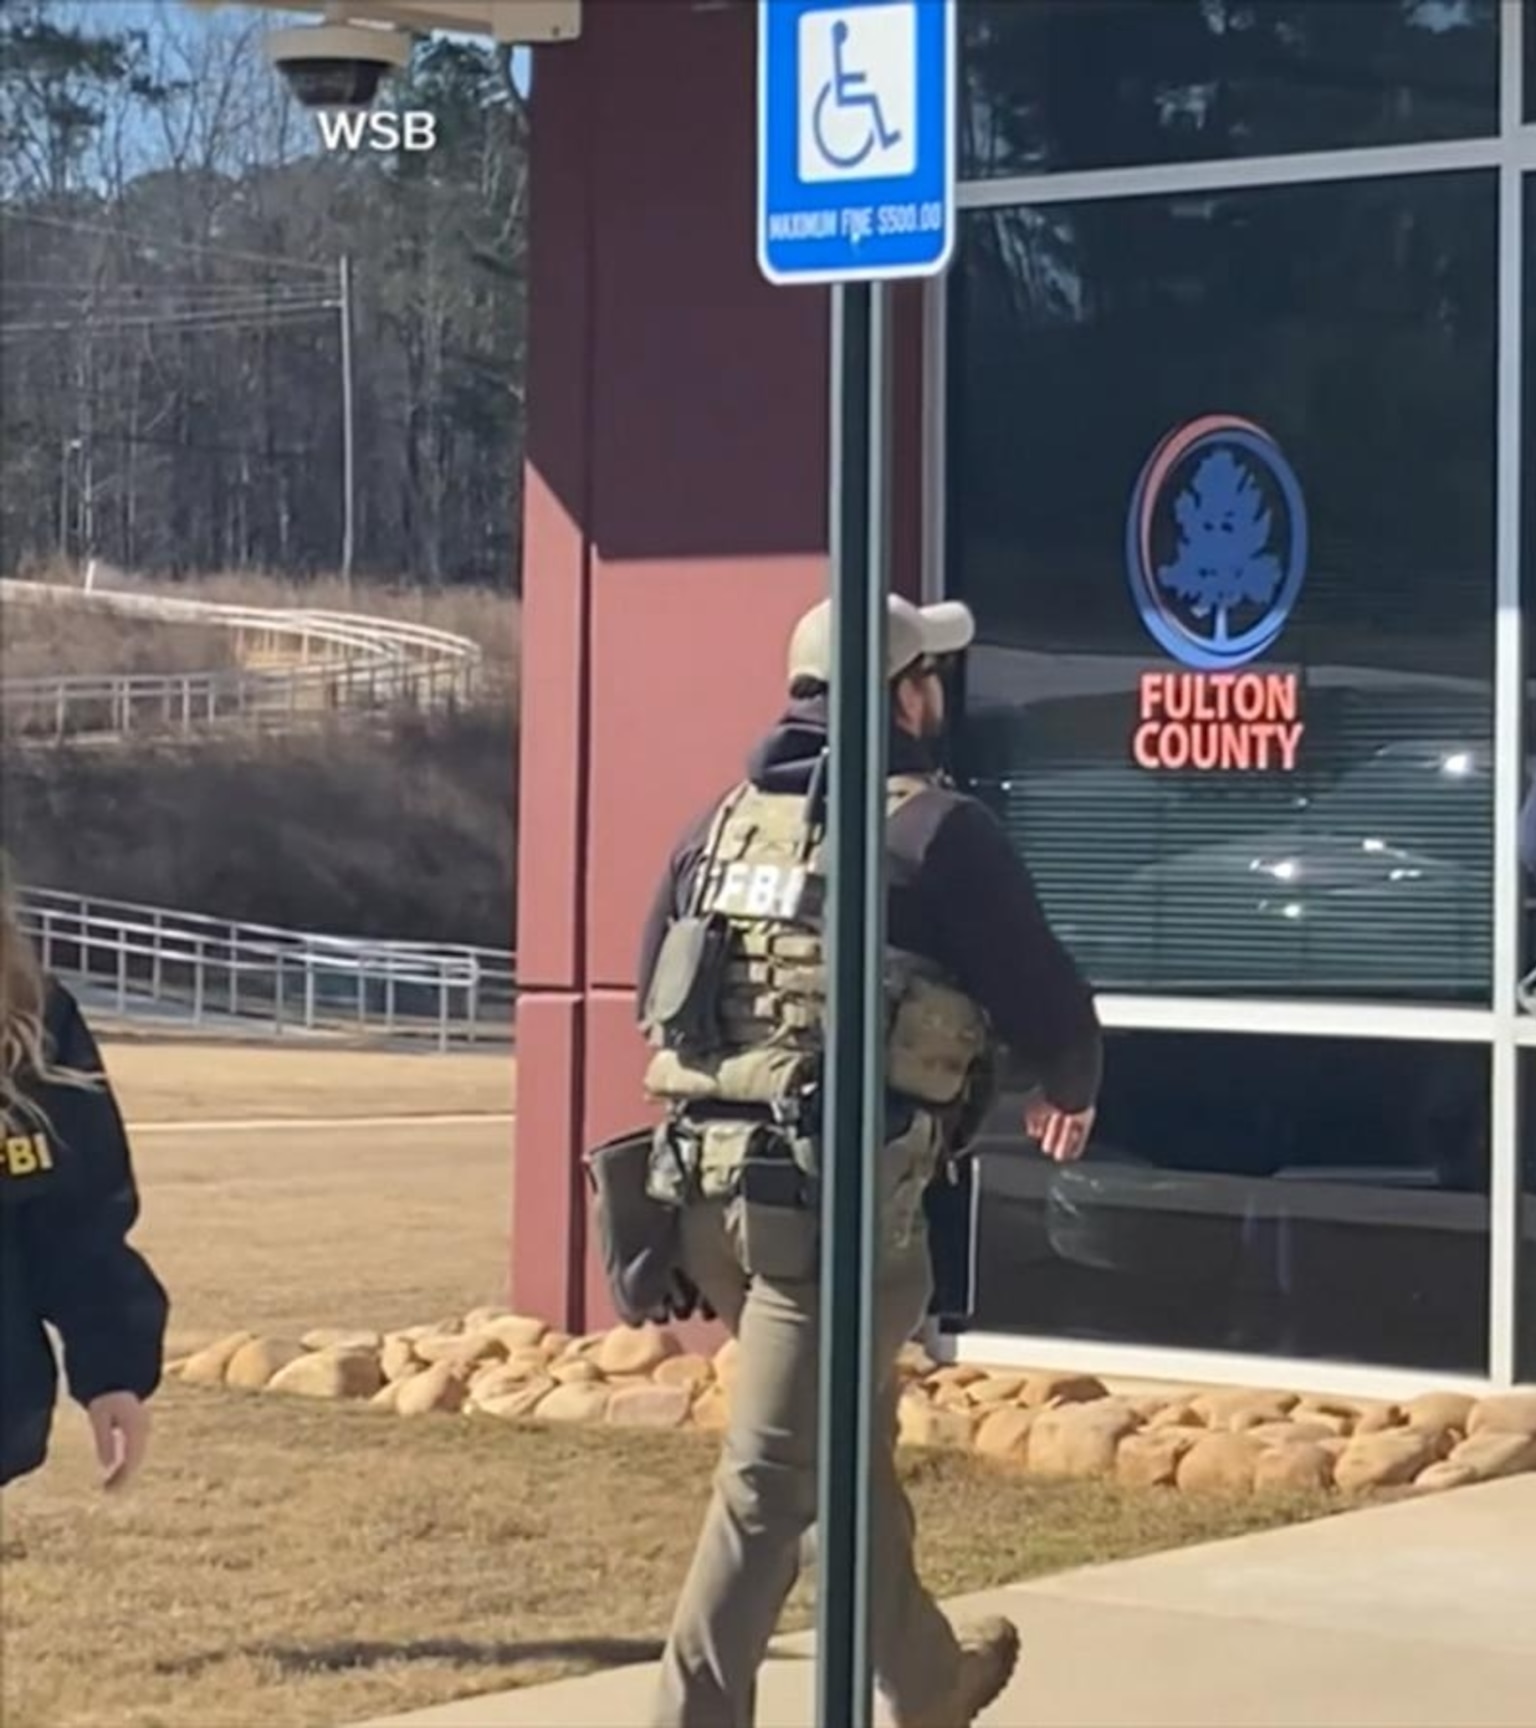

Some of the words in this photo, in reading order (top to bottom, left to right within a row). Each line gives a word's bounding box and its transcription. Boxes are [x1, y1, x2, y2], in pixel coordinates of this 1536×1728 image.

[769, 210, 837, 241] MAXIMUM
[1141, 673, 1296, 719] FULTON
[1134, 722, 1304, 770] COUNTY
[712, 861, 806, 919] FBI
[0, 1132, 53, 1176] BI
